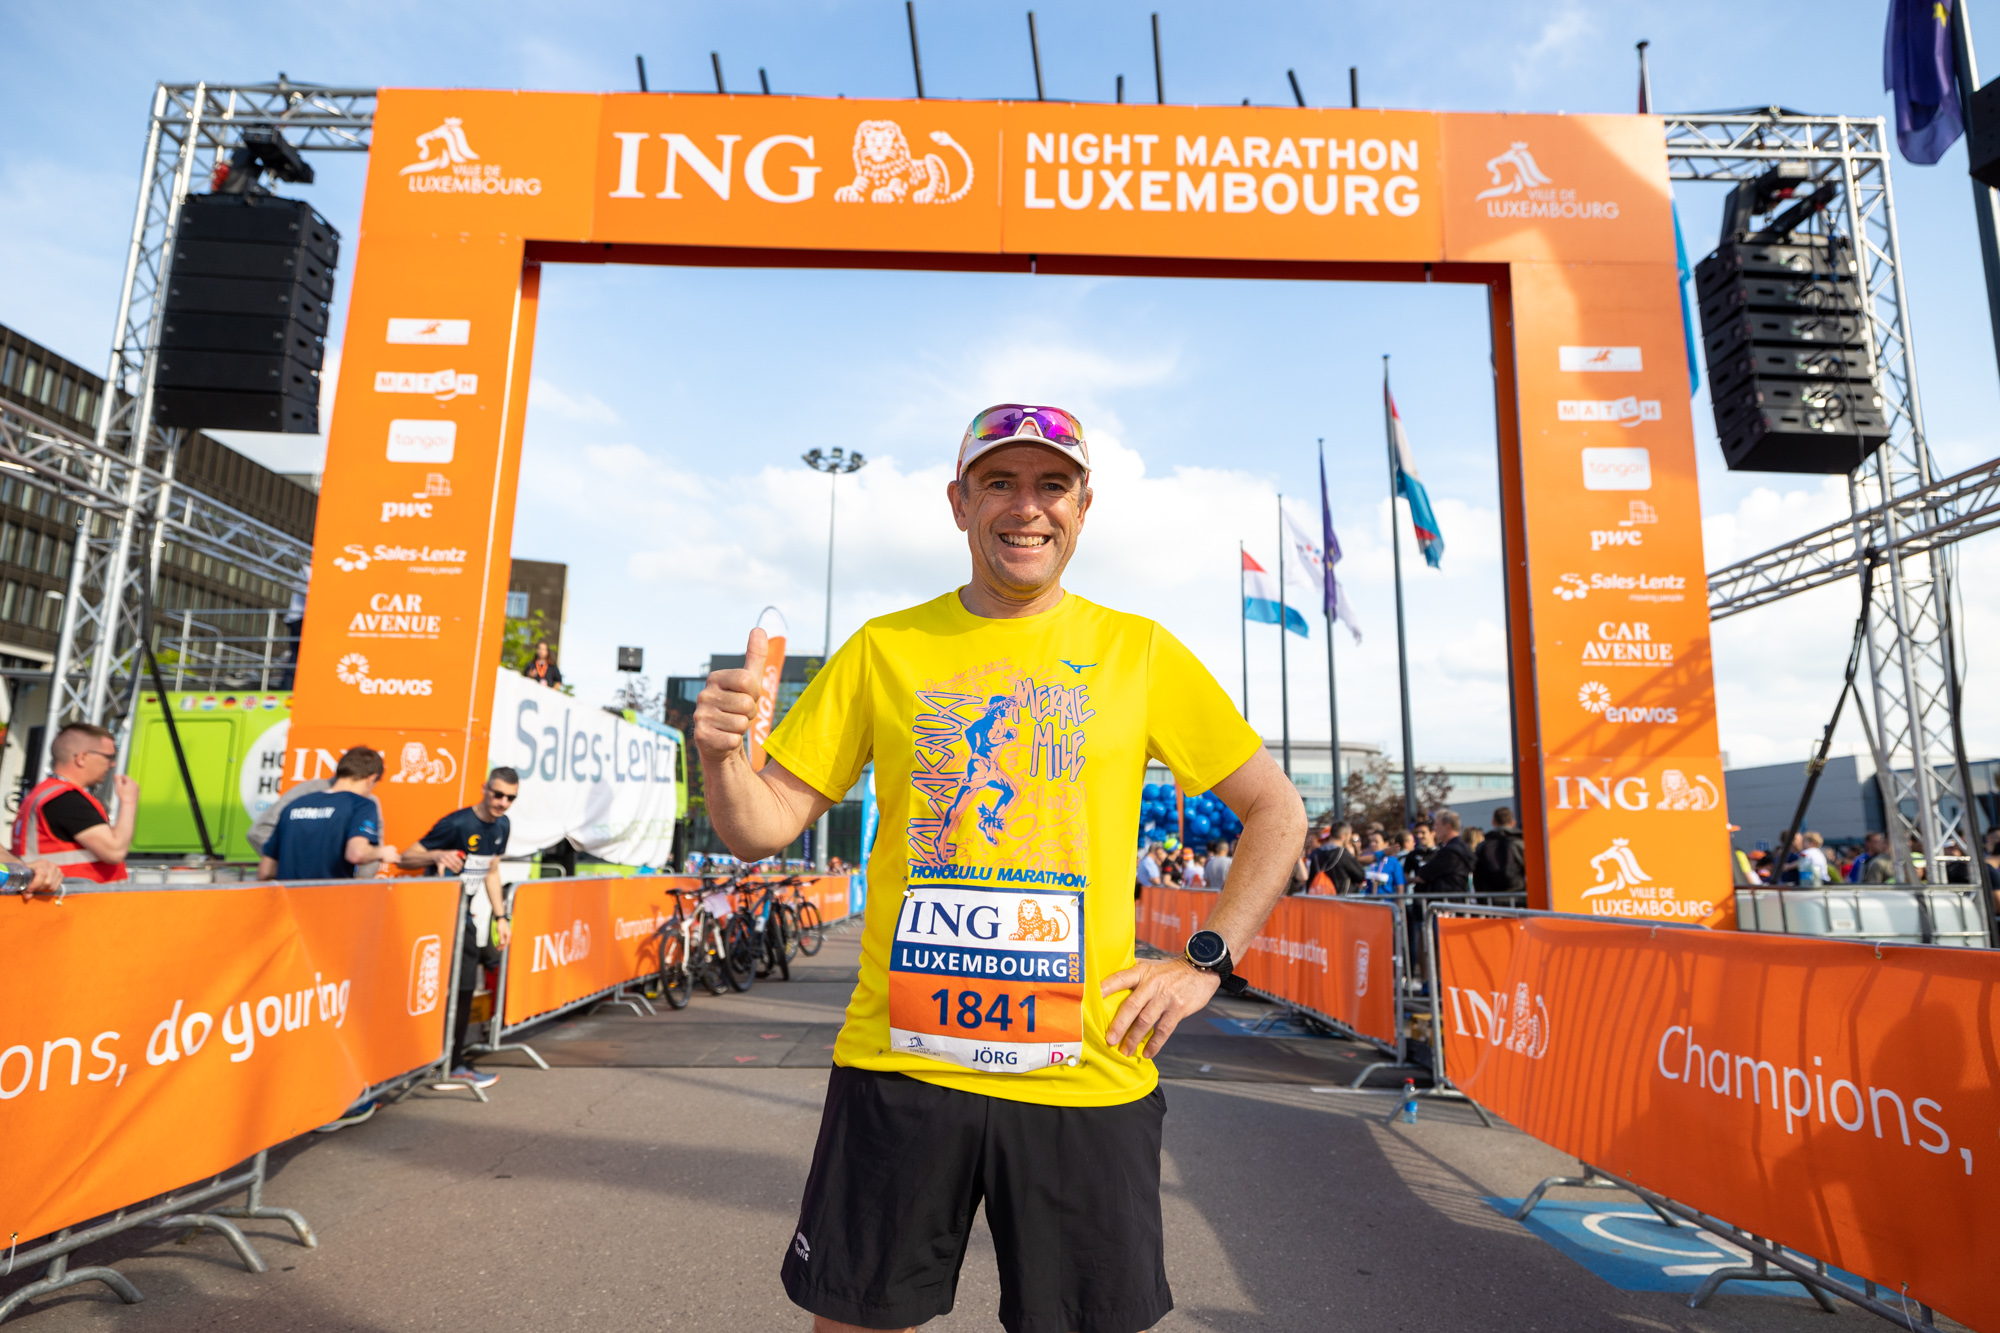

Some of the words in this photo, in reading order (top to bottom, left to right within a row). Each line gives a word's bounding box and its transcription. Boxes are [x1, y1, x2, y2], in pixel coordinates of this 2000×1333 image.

[1026, 132, 1159, 166] NIGHT
[1175, 134, 1419, 171] MARATHON
[452, 164, 482, 177] VILLE
[484, 165, 501, 178] DE
[608, 131, 822, 203] ING
[408, 175, 542, 196] LUXEMBOURG
[1025, 168, 1420, 217] LUXEMBOURG
[1528, 189, 1557, 200] VILLE
[1559, 189, 1576, 201] DE
[1486, 200, 1620, 219] LUXEMBOURG
[377, 371, 477, 392] MATCH
[1560, 398, 1659, 419] MATCH
[380, 501, 433, 522] pwc
[1590, 529, 1642, 551] pwc
[372, 544, 467, 563] Sales-Lentz
[1590, 573, 1686, 589] Sales-Lentz
[370, 592, 422, 613] CAR
[349, 612, 441, 633] AVENUE
[1598, 621, 1651, 641] CAR
[1582, 640, 1673, 661] AVENUE
[359, 677, 432, 696] enovos
[1012, 678, 1096, 730] MERRIE
[754, 697, 774, 746] ING
[1605, 706, 1678, 724] enovos
[1030, 722, 1086, 782] MILE
[1554, 775, 1650, 811] ING
[910, 864, 993, 881] HONOLULU
[997, 867, 1087, 889] MARATHON
[1629, 887, 1657, 899] VILLE
[1659, 887, 1675, 899] DE
[1591, 899, 1714, 917] LUXEMBOURG
[906, 901, 1002, 940] ING
[531, 934, 569, 974] ING
[902, 948, 1067, 977] LUXEMBOURG
[1069, 953, 1080, 982] 2023
[931, 988, 1037, 1033] 1841
[1448, 986, 1508, 1047] ING
[0, 1030, 128, 1100] ons,
[146, 998, 213, 1066] do
[222, 988, 314, 1063] your
[973, 1046, 1018, 1066] JÖRG
[1050, 1051, 1064, 1064] D
[1657, 1024, 1973, 1176] Champions,
